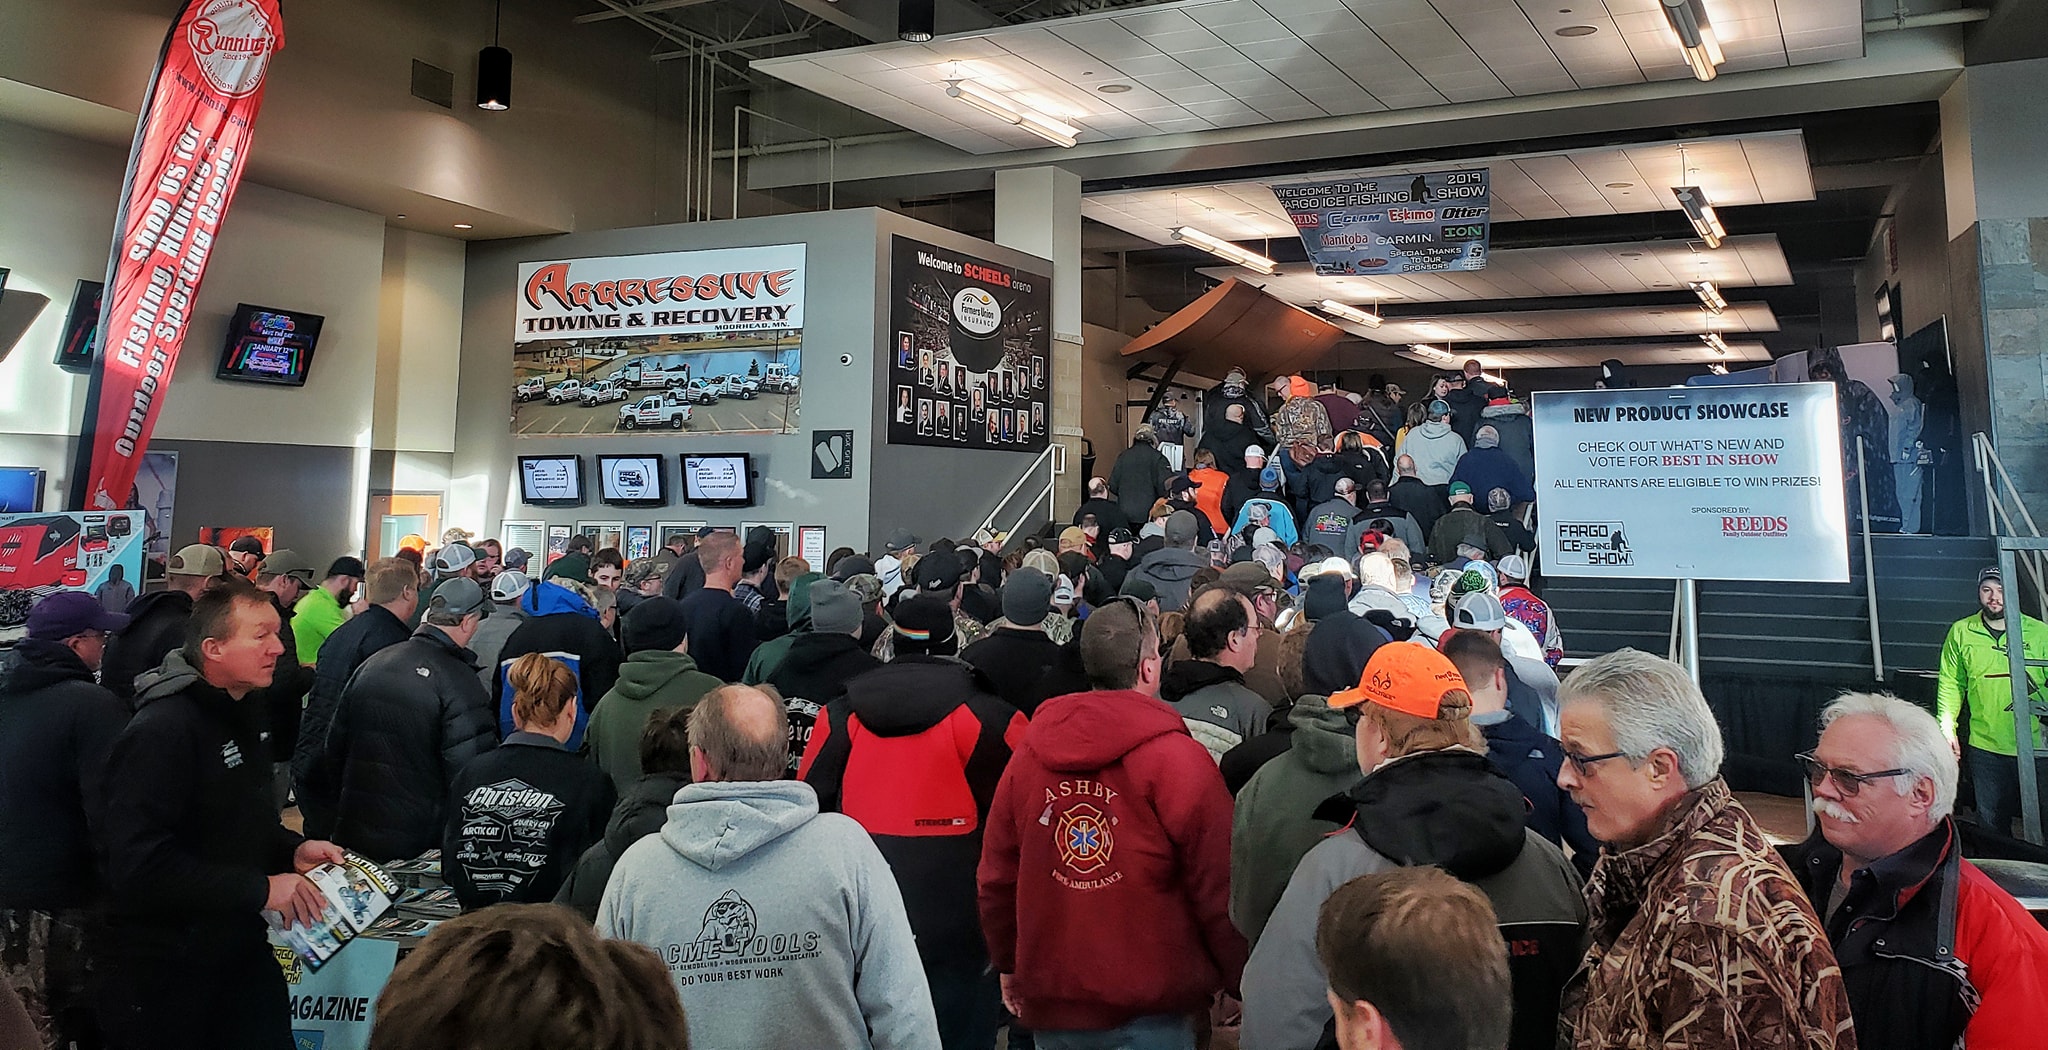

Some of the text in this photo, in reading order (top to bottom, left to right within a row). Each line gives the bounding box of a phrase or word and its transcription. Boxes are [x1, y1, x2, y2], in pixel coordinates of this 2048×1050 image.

[1447, 173, 1481, 185] 2019
[129, 120, 201, 263] Shop us for
[1275, 186, 1331, 198] WELCOME
[1322, 195, 1345, 207] ICE
[1349, 191, 1409, 206] FISHING
[1437, 185, 1485, 199] SHOW
[1292, 214, 1319, 227] EEDS
[1387, 208, 1435, 222] Eskimo
[1444, 226, 1483, 238] ION
[1320, 233, 1368, 247] Manitoba
[117, 264, 177, 369] Fishing,
[156, 162, 212, 258] Hunting
[917, 251, 1032, 293] Welcome to SCHEELS arena
[525, 262, 797, 313] AGGRESSIVE
[114, 146, 237, 458] Outdoor Sporting Goods
[961, 302, 994, 319] Farmers Union
[524, 303, 796, 334] TOWING & RECOVERY
[961, 315, 994, 328] INSURANCE
[715, 323, 771, 331] MOORHEAD,
[252, 344, 283, 353] JANUARY
[1574, 402, 1789, 422] NEW PRODUCT SHOWCASE
[1578, 438, 1784, 452] CHECK OUT WHAT'S NEW AND
[1588, 453, 1779, 467] VOTE FOR BEST IN SHOW
[1554, 476, 1821, 489] ALL ENTRANTS ARE ELIGIBLE TO WIN PRIZES!
[1691, 506, 1750, 514] SPONSORED BY:
[1721, 516, 1788, 532] REEDS
[1559, 525, 1608, 538] FARGO
[1559, 540, 1610, 552] ICE FISHING
[1588, 552, 1630, 565] SHOW
[468, 787, 554, 809] Christian
[1045, 780, 1118, 804] ASHBY
[463, 827, 500, 836] ARCTIC CAT
[344, 852, 399, 895] MATTRACKS
[1069, 870, 1124, 889] AMBULANCE
[736, 931, 819, 957] TOOLS
[680, 961, 718, 970] REMODELING
[725, 957, 771, 966] WOODWORKING
[681, 967, 784, 986] DO YOUR BEST WORK
[289, 994, 369, 1022] AGAZINE
